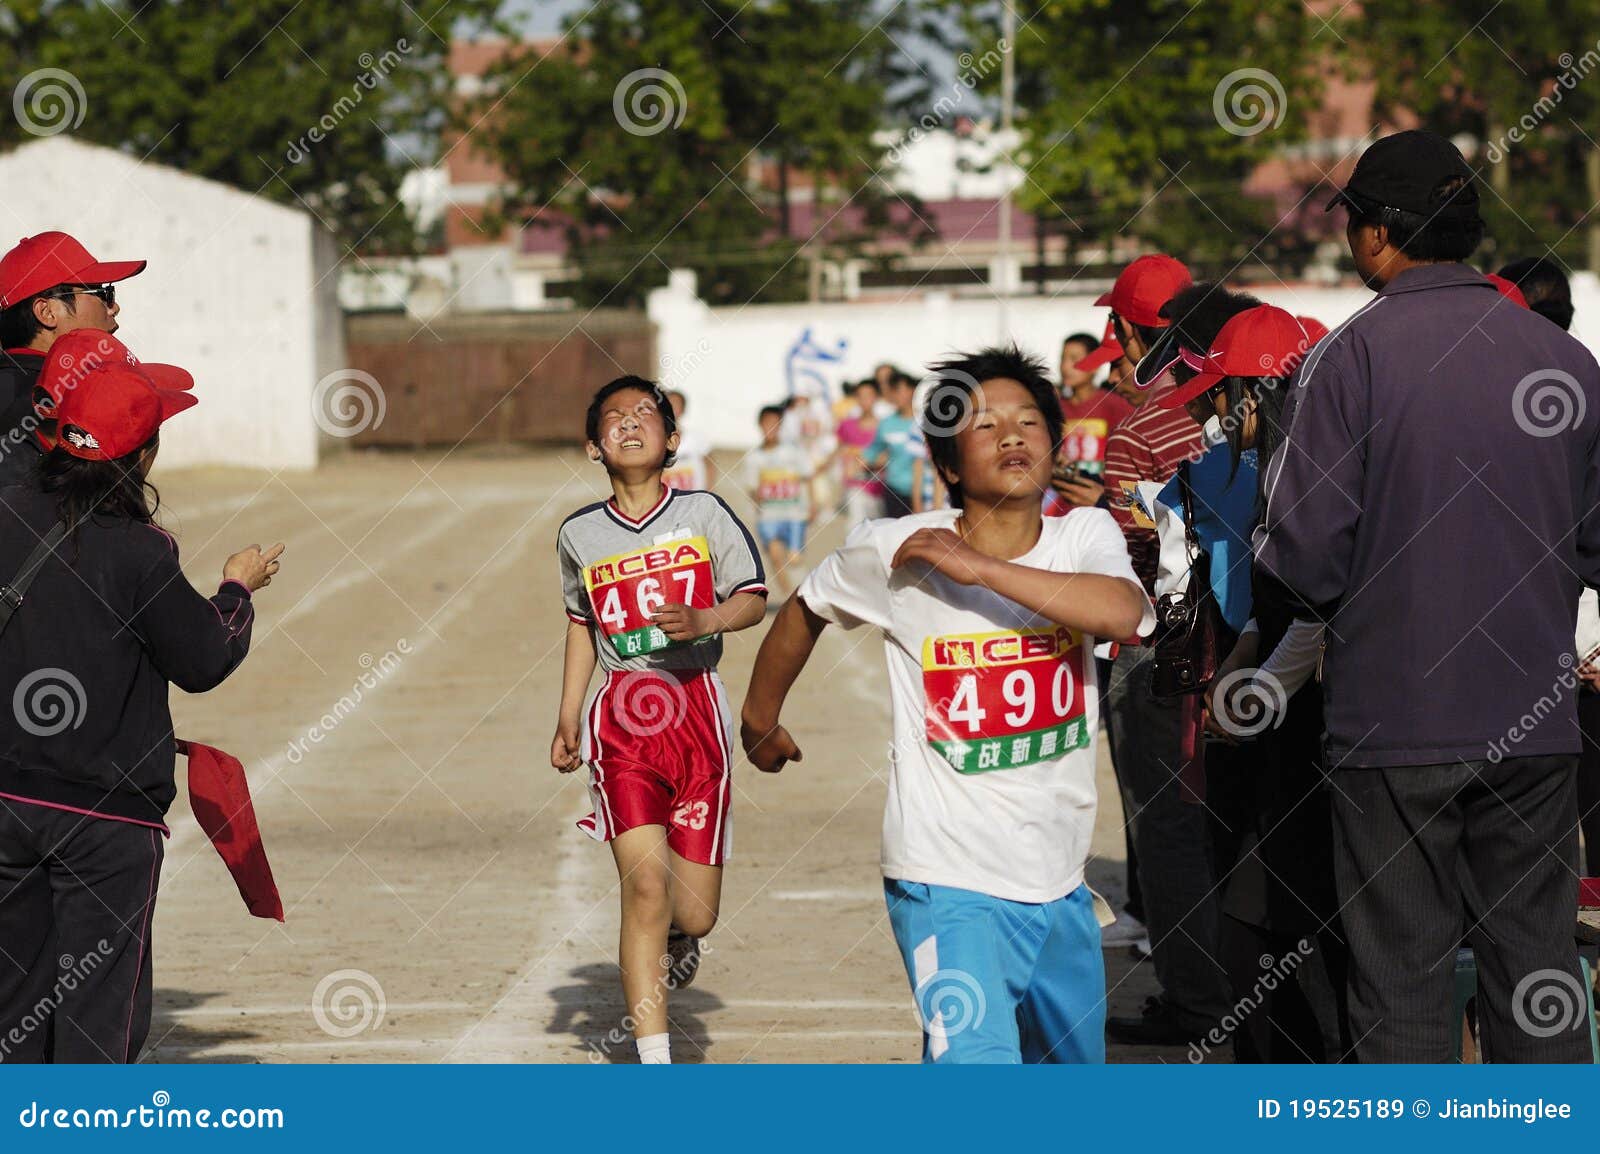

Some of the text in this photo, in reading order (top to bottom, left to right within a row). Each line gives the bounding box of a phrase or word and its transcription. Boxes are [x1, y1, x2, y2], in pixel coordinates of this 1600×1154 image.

[618, 545, 701, 576] CBA
[600, 569, 696, 629] 467
[982, 626, 1073, 662] CBA
[947, 661, 1074, 733] 490
[943, 722, 1080, 770] 挑战新高度
[673, 800, 709, 830] 23
